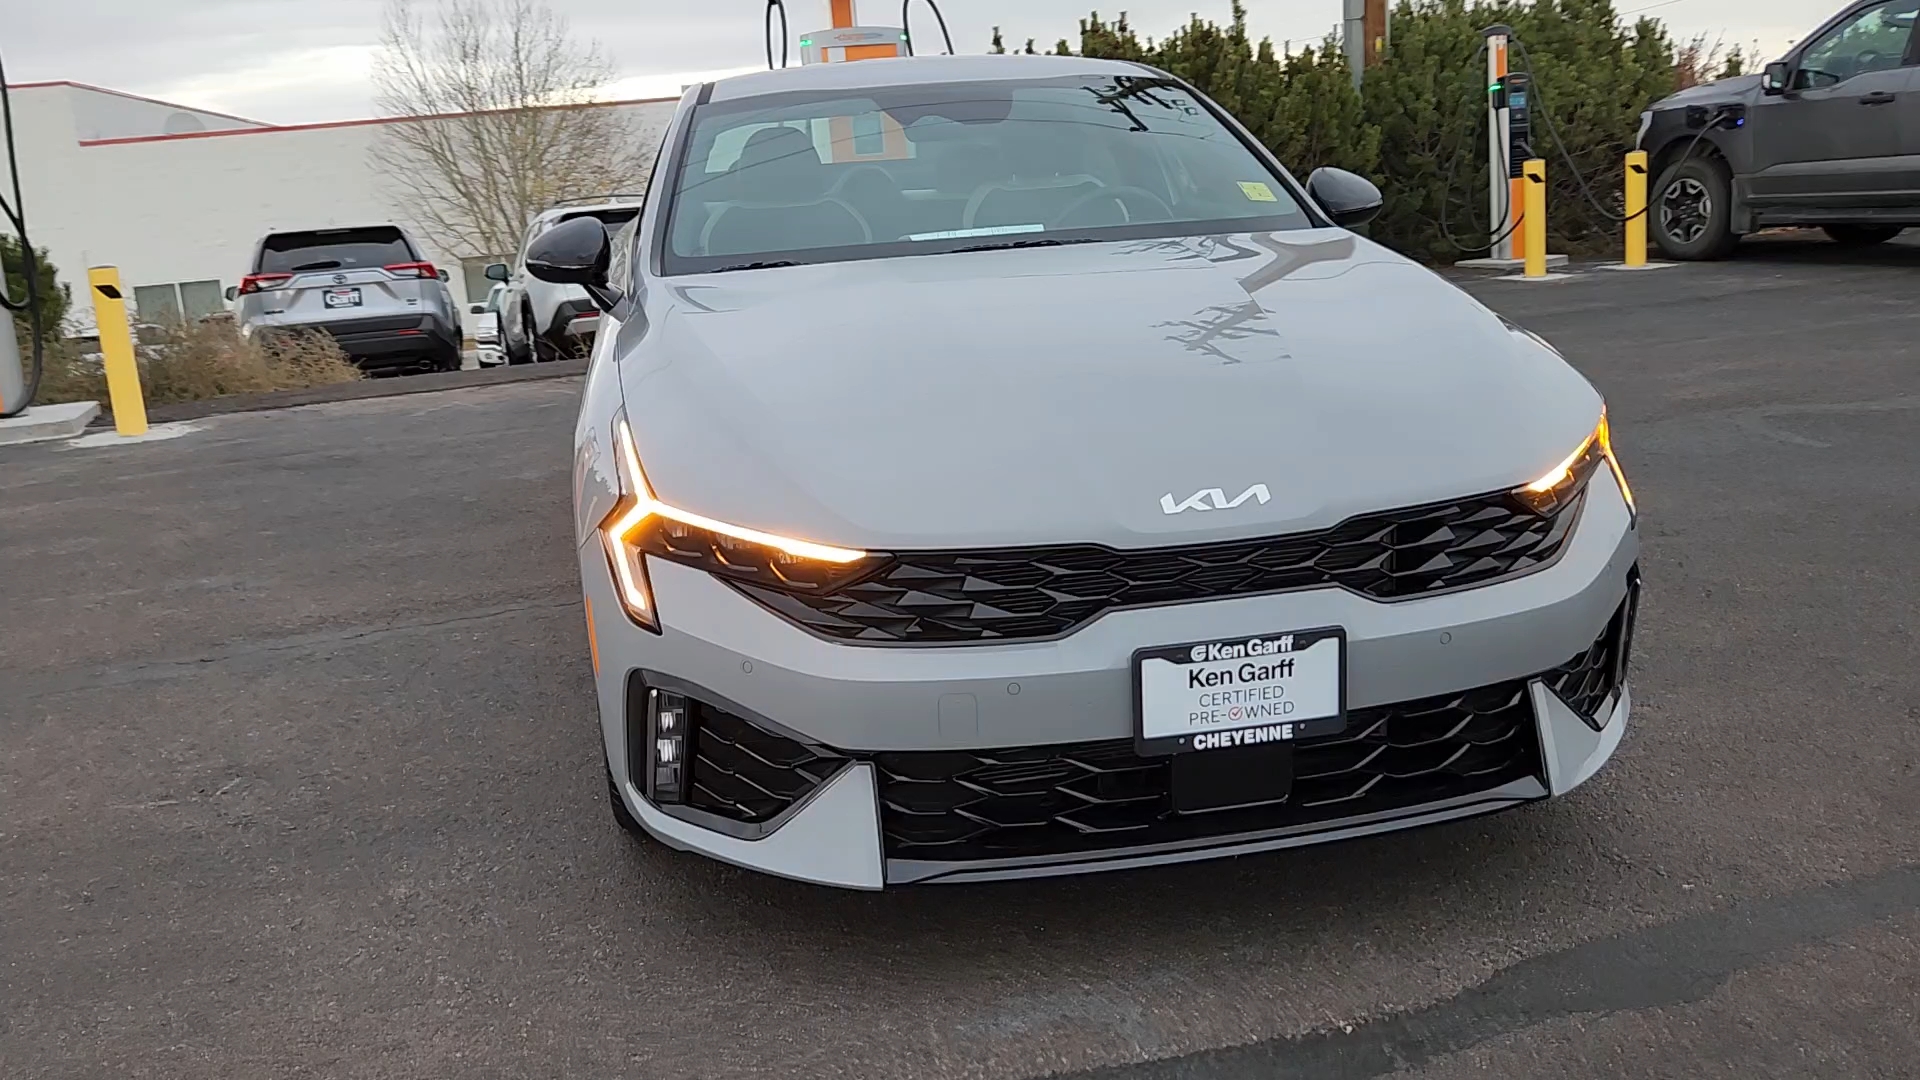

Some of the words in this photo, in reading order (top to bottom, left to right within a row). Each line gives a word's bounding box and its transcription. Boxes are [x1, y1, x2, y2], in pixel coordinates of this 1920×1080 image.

[1160, 483, 1271, 514] KIA
[1208, 643, 1244, 661] Ken
[1247, 635, 1294, 656] Garff
[1189, 668, 1233, 689] Ken
[1238, 658, 1295, 681] Garff
[1199, 685, 1285, 708] CERTIFIED
[1193, 724, 1294, 750] CHEYENNE
